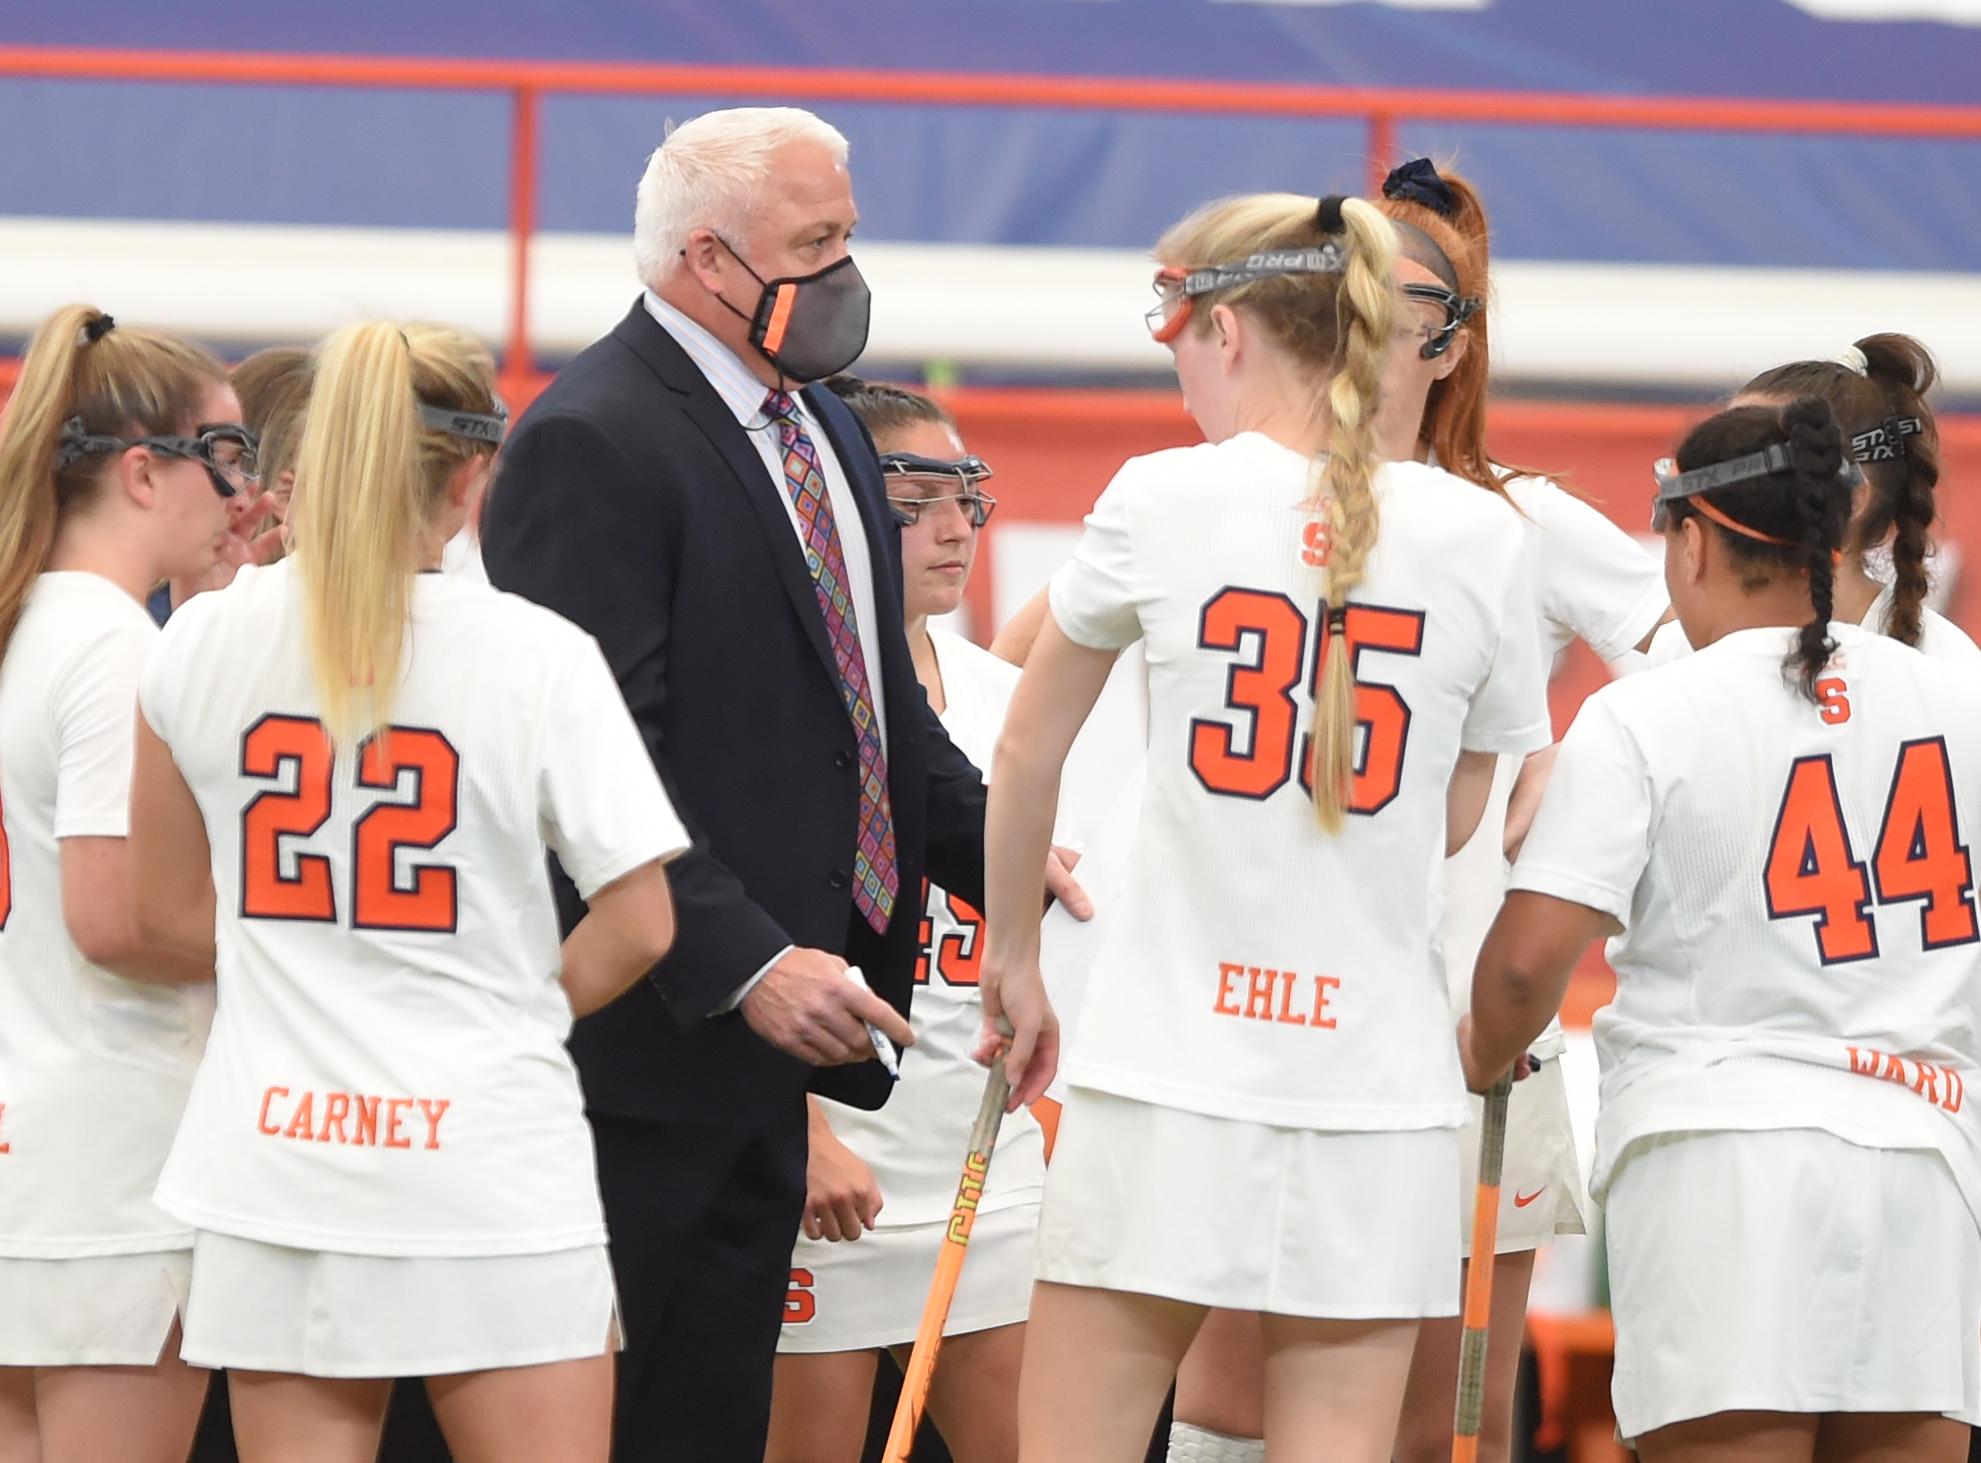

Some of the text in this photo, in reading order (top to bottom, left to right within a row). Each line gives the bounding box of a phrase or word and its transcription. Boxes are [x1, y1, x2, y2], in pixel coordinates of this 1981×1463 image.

[1188, 585, 1425, 817] 35
[1815, 677, 1851, 726] S
[239, 712, 459, 934] 22
[1762, 735, 1981, 967] 44
[1213, 962, 1340, 1030] EHLE
[1845, 1046, 1964, 1114] WARD
[257, 1085, 450, 1150] CARNEY
[782, 1268, 816, 1324] S
